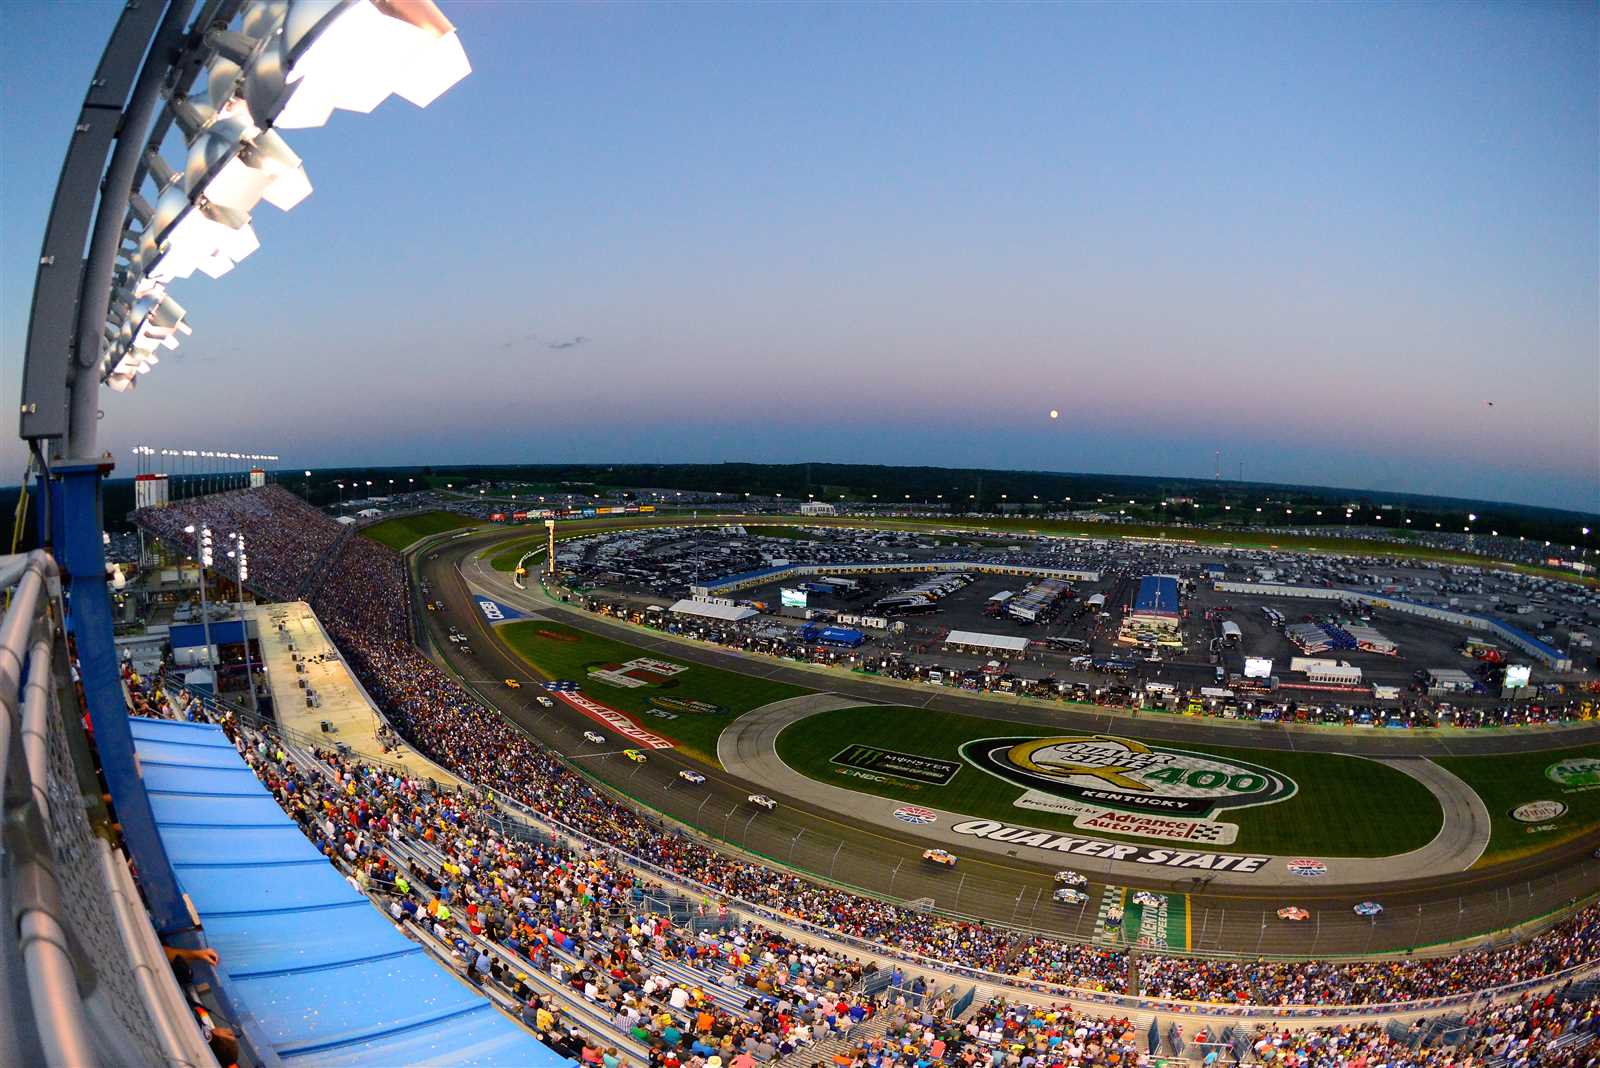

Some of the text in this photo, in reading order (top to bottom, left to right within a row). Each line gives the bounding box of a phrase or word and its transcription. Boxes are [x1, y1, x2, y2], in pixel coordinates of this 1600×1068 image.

[618, 724, 671, 748] ZONE
[1054, 743, 1176, 765] QUAKER
[1060, 753, 1157, 770] STATE
[1142, 767, 1267, 792] 400
[1021, 799, 1099, 815] Presented by
[1081, 790, 1189, 809] KENTUCKY
[1083, 818, 1187, 839] Auto Parts
[1098, 811, 1189, 830] Advance
[952, 820, 1270, 874] QUAKER STATE
